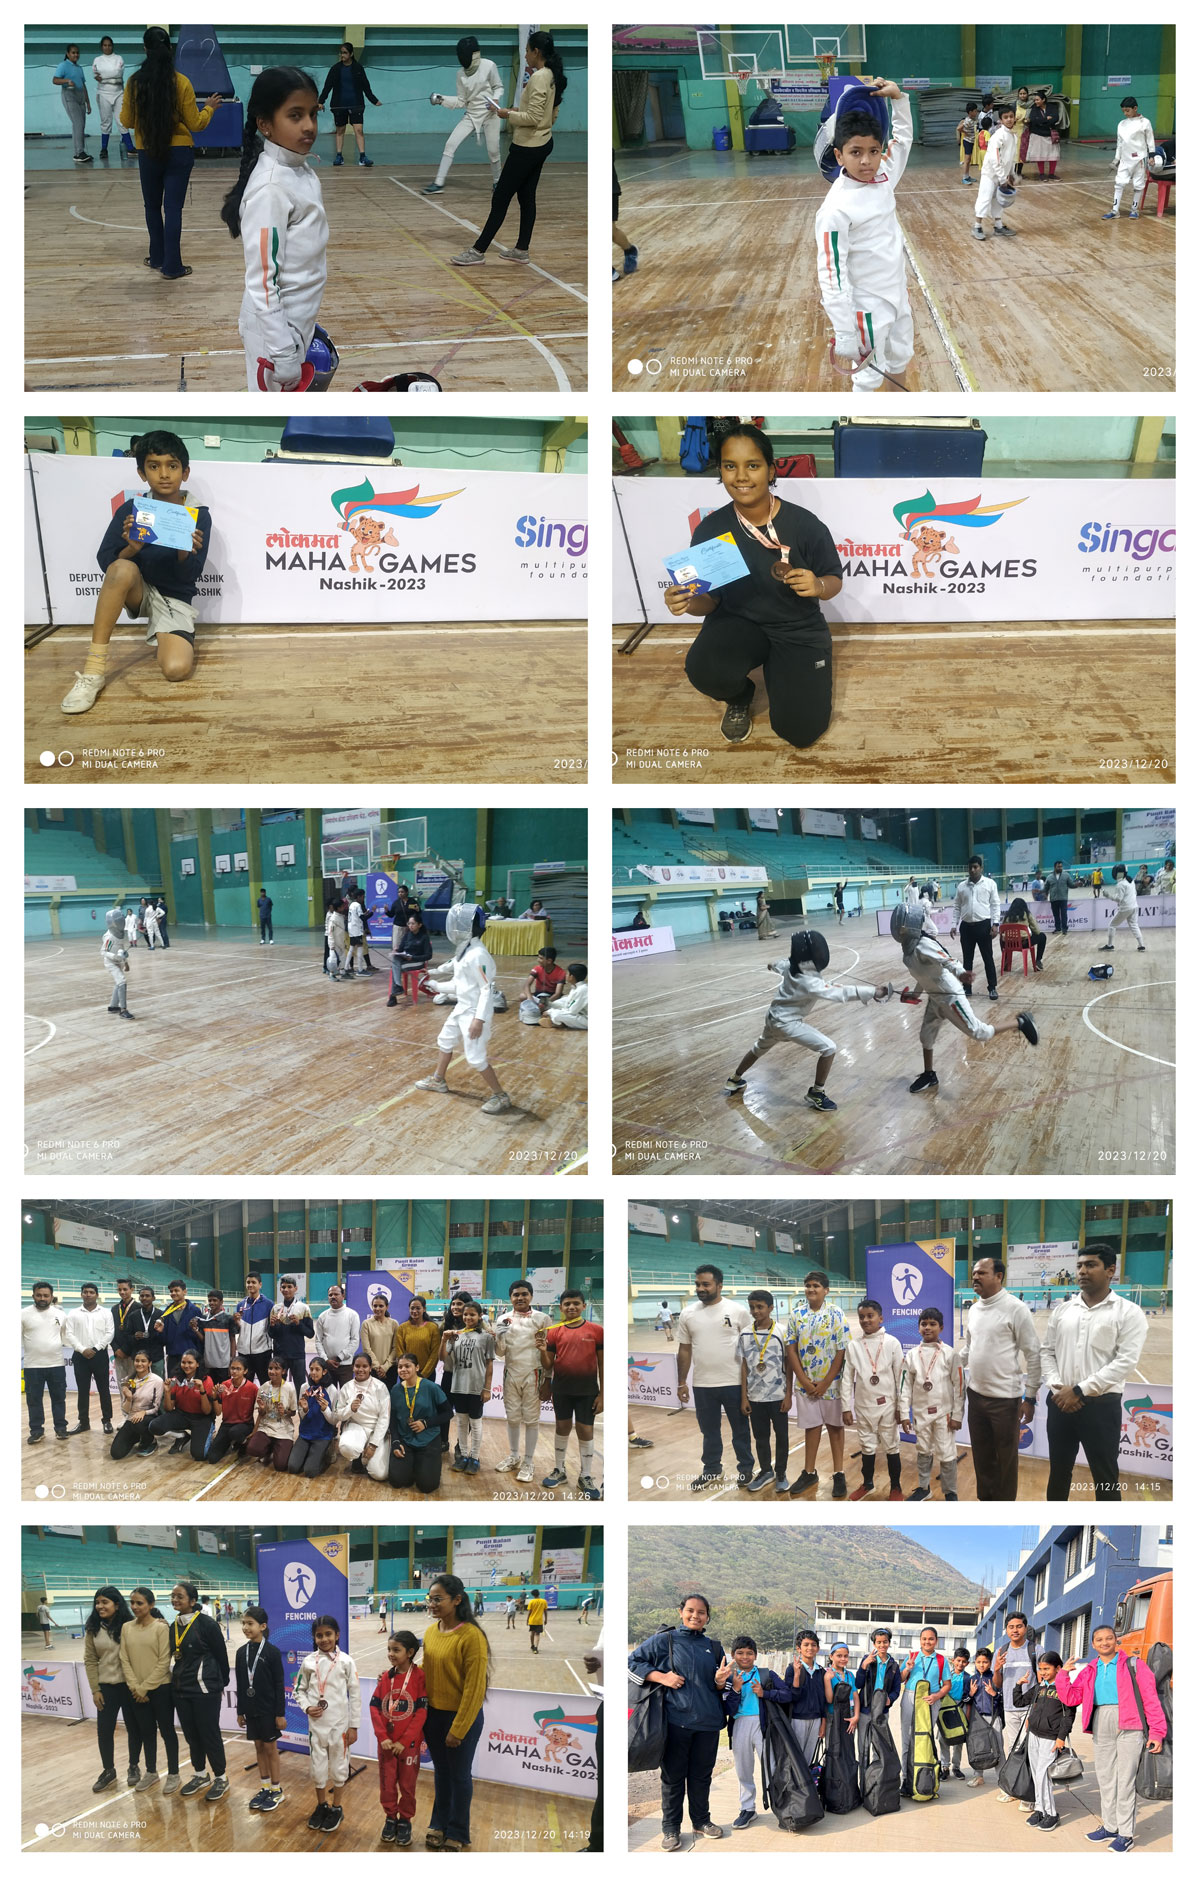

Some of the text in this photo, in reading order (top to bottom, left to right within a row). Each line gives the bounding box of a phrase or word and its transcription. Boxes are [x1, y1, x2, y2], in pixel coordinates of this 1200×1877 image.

[266, 527, 342, 549] लोकमत
[266, 551, 477, 574] MAHA GAMES
[939, 558, 1037, 578] GAMES
[69, 573, 224, 583] DEPUTY ASHIK
[658, 581, 673, 589] DEP
[195, 588, 221, 597] ASHIK
[1068, 917, 1089, 925] AMES
[639, 1384, 672, 1396] GAMES
[285, 1612, 317, 1621] FENCING
[41, 1694, 73, 1706] GAMES
[489, 1728, 540, 1746] लोकमत
[488, 1742, 541, 1760] MAHA
